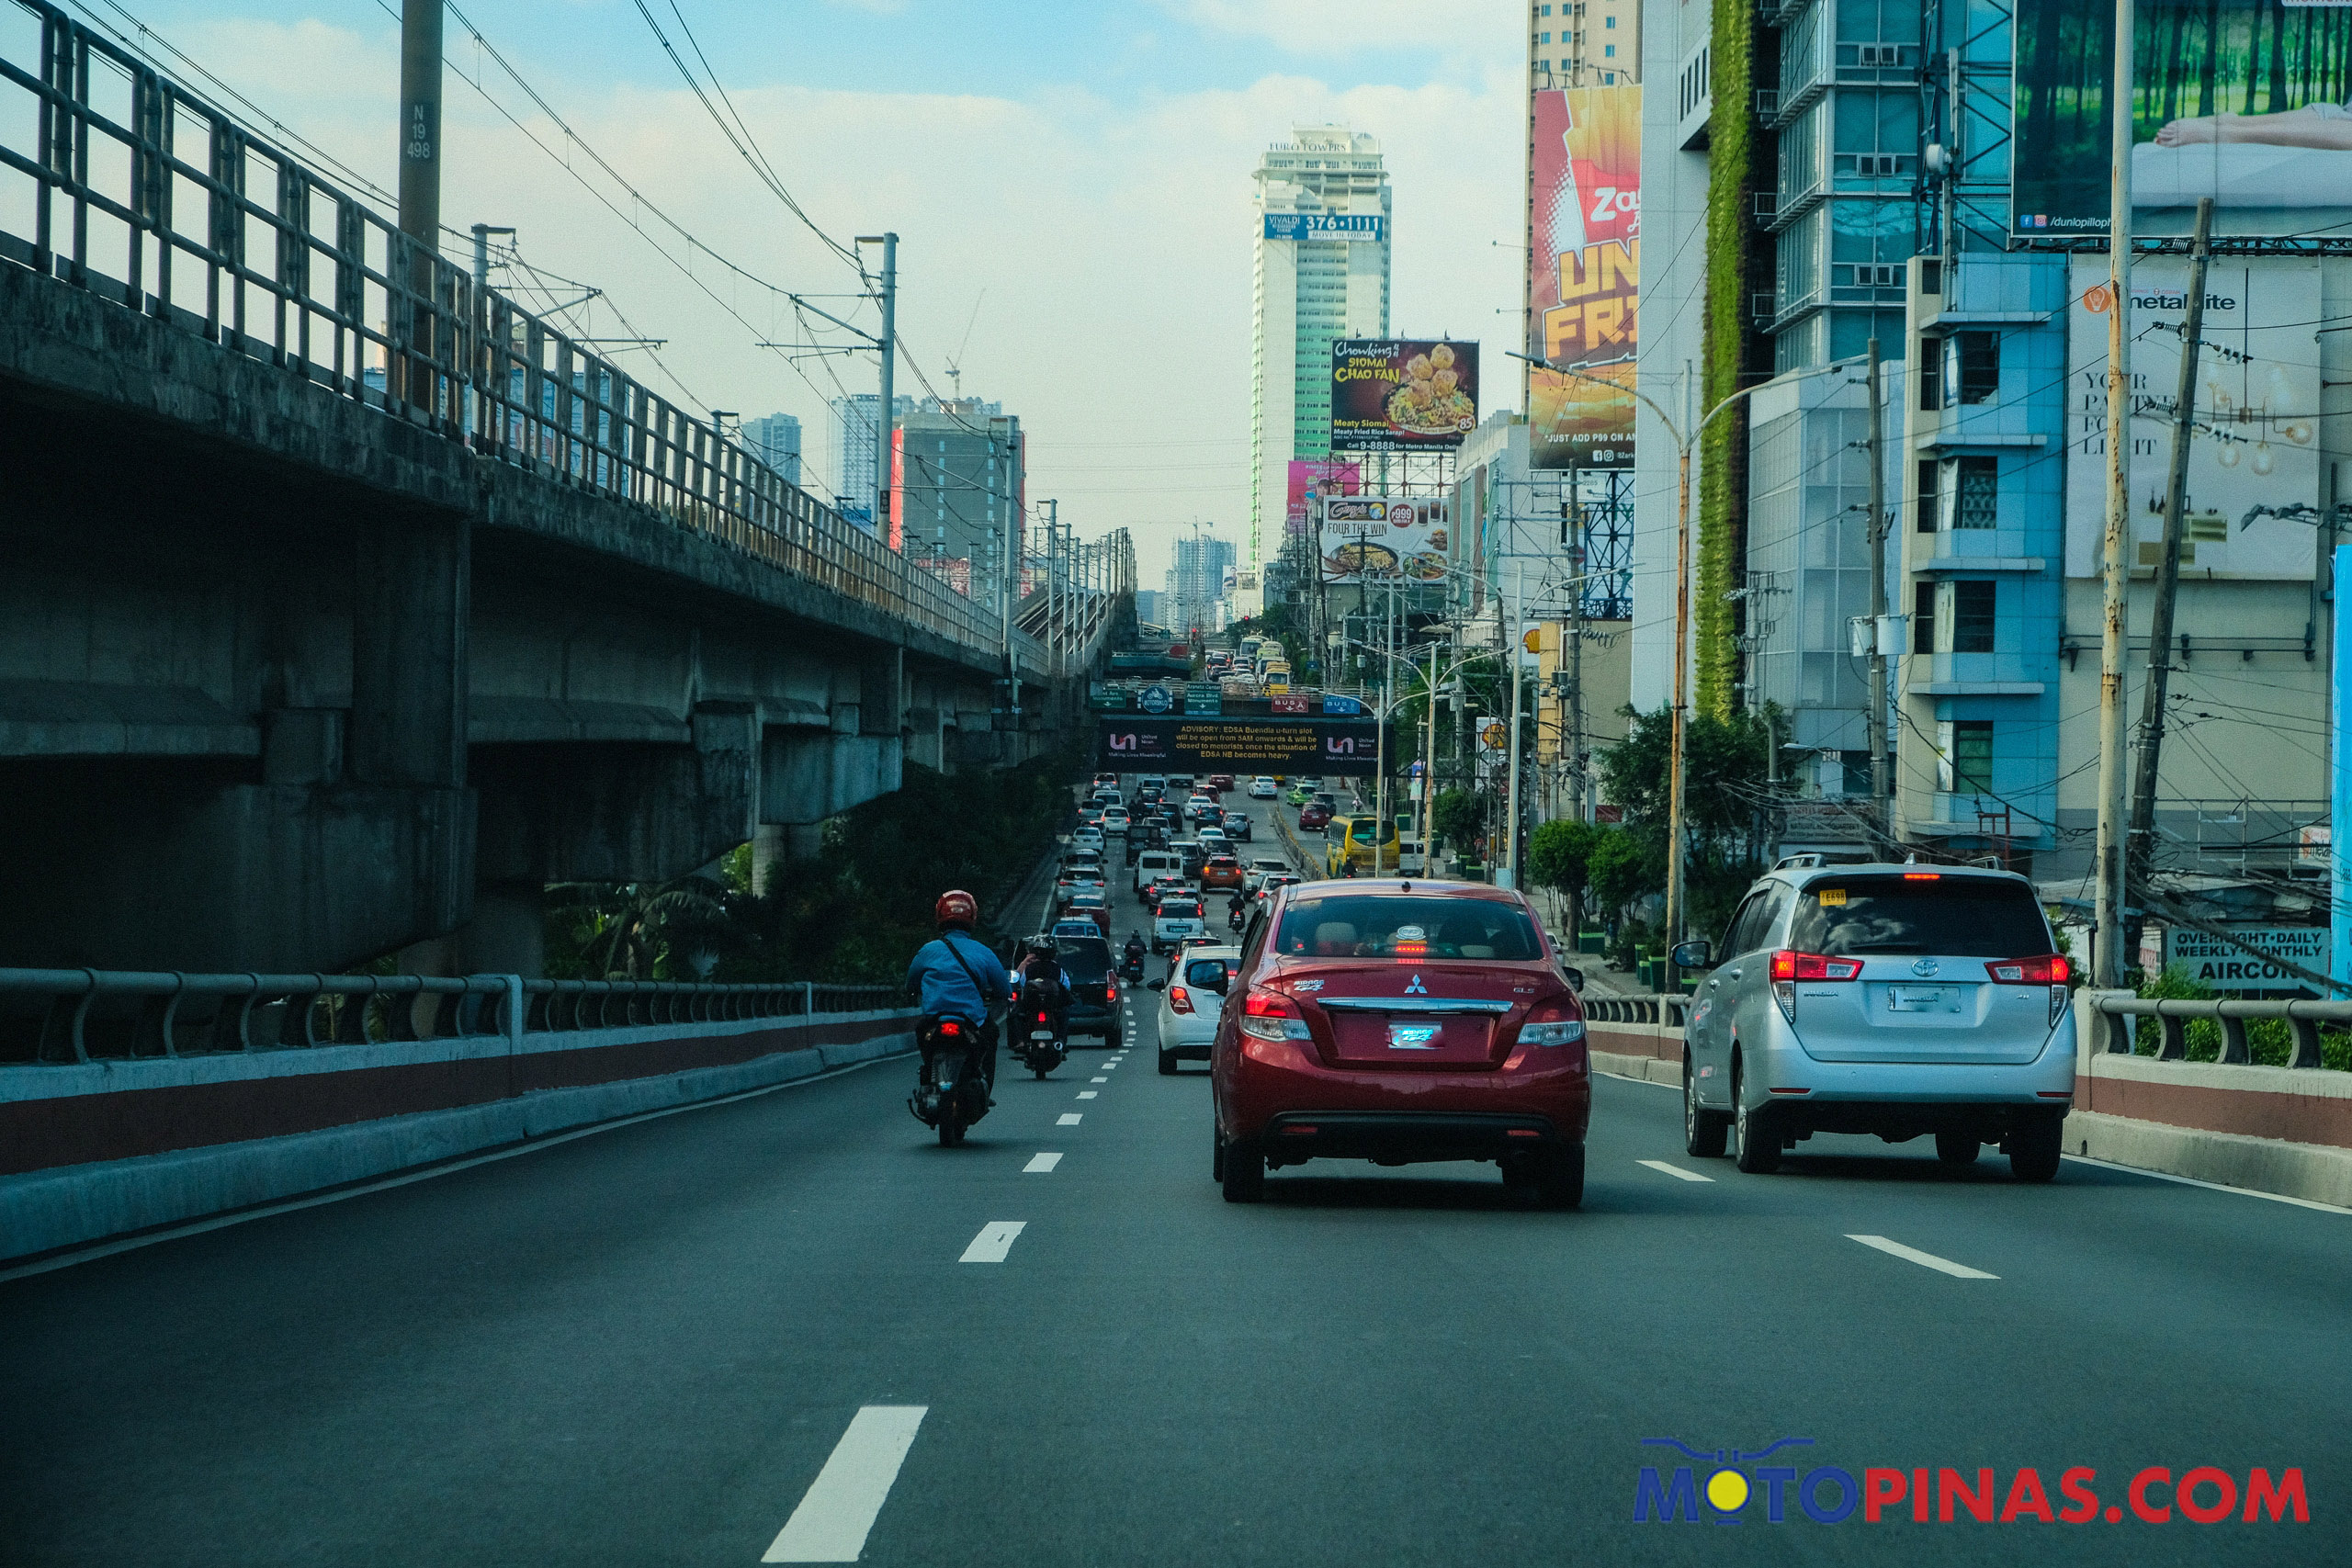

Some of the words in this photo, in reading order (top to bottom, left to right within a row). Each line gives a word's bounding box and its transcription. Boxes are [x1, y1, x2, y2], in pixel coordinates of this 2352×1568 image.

[414, 105, 424, 120] N
[412, 122, 425, 140] 19
[407, 141, 430, 159] 498
[1269, 215, 1301, 224] VIVALDI
[1334, 341, 1392, 359] Chowking
[1348, 357, 1387, 367] SIOMAI
[1334, 367, 1373, 383] CHAO
[1374, 367, 1400, 383] FAN
[1333, 419, 1360, 428] Meaty
[1459, 417, 1473, 430] 85
[1333, 428, 1353, 436] Meaty
[1572, 434, 1590, 442] ADD
[1611, 433, 1623, 442] ON
[1360, 441, 1396, 450] 9-8888
[1328, 523, 1350, 535] FOUR
[1351, 524, 1368, 535] THE
[1370, 524, 1387, 536] WIN
[1200, 735, 1218, 743] open
[1268, 752, 1292, 761] heavy.
